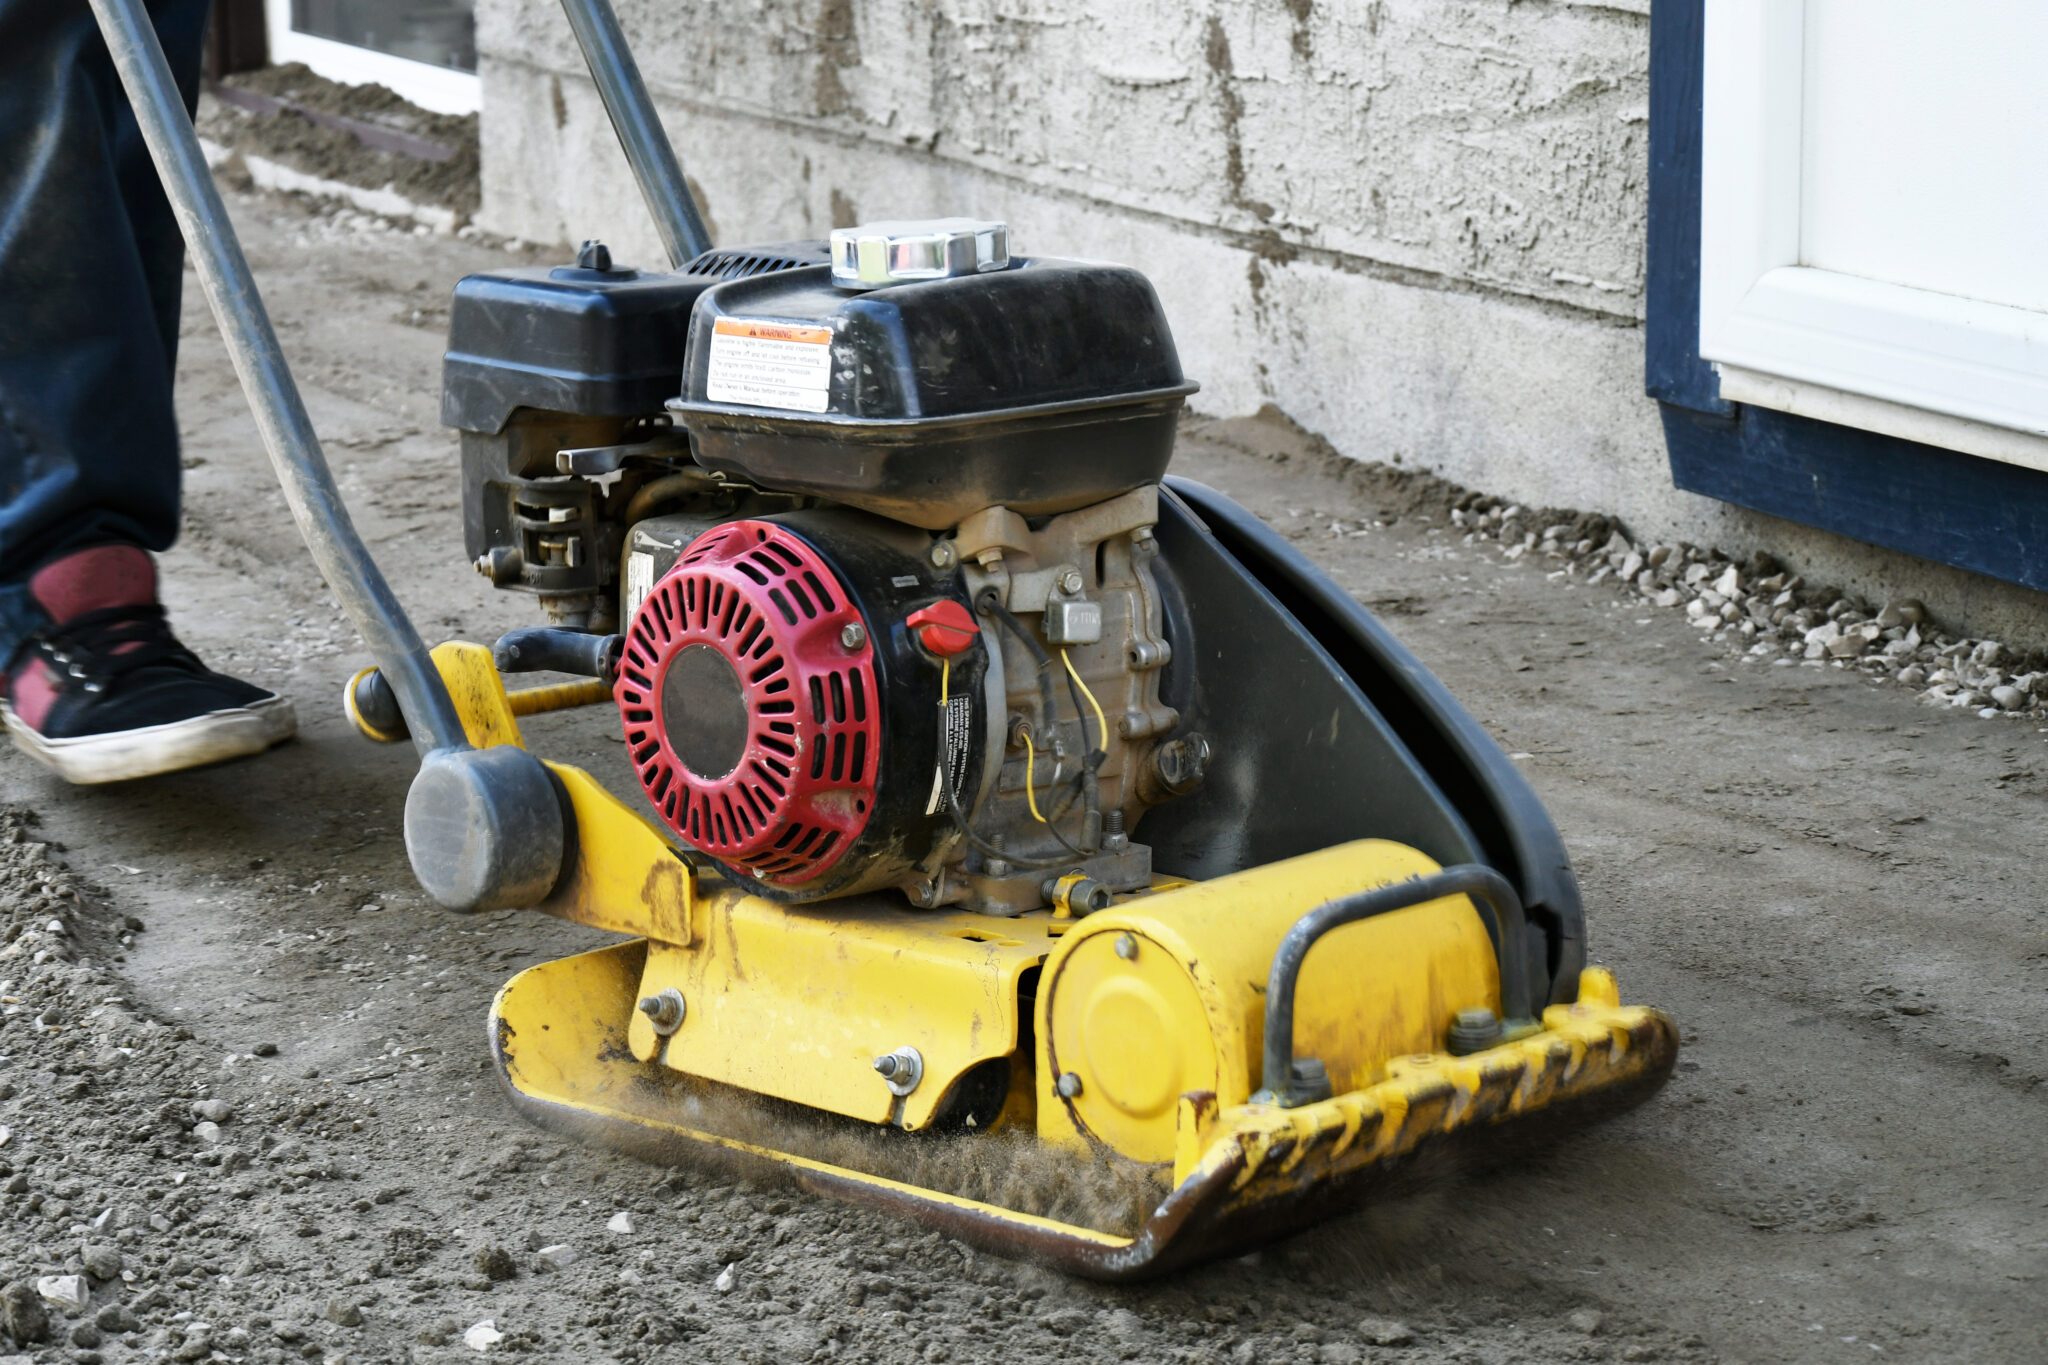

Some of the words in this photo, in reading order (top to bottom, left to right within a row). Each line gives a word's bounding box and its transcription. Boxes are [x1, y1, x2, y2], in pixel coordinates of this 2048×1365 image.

[760, 327, 792, 339] WARNING
[954, 698, 959, 706] CE
[962, 729, 970, 753] IGNITION
